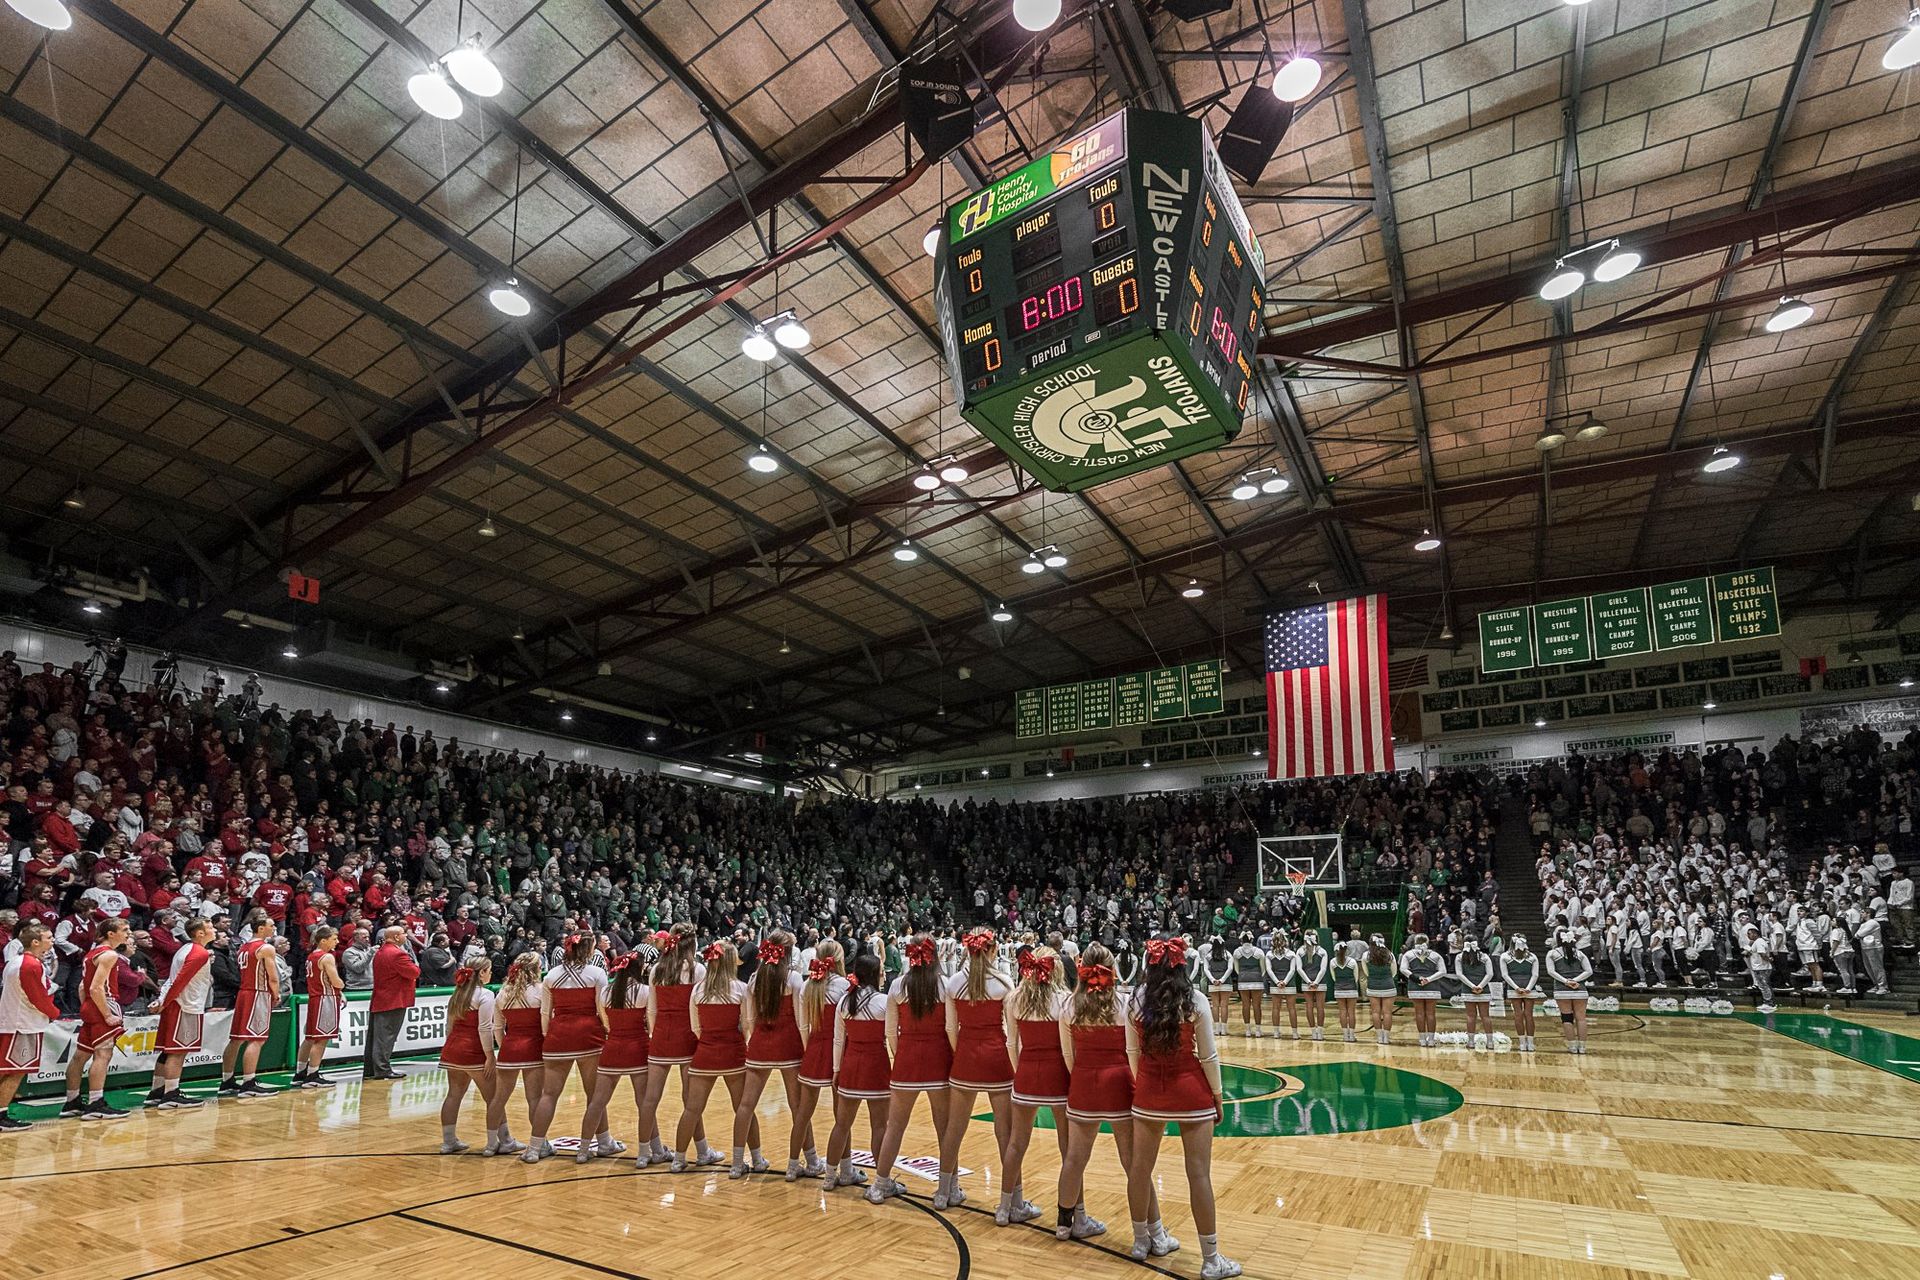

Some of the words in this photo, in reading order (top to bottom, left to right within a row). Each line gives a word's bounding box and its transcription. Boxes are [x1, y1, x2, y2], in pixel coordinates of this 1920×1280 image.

[1071, 131, 1101, 163] GO
[997, 172, 1027, 196] Henry
[997, 180, 1033, 206] County
[1142, 162, 1189, 233] NEW
[997, 186, 1039, 216] Hospital
[1101, 202, 1115, 229] 0
[1015, 212, 1050, 241] player
[1092, 258, 1135, 287] Guests
[969, 269, 983, 293] 0
[1152, 236, 1175, 330] CASTLE
[1119, 277, 1139, 314] 0
[1021, 276, 1083, 331] 8:00
[964, 322, 993, 345] Home
[984, 338, 1002, 372] 0
[1031, 340, 1067, 368] period
[1033, 363, 1101, 398] SCHOOL
[1147, 356, 1212, 425] TROJANS
[1013, 396, 1040, 422] HIGH
[1013, 424, 1066, 463] CHRYSLER
[1134, 441, 1167, 458] NEW
[1069, 453, 1129, 467] CASTLE
[1732, 574, 1755, 586] BOYS
[297, 579, 309, 599] J
[1670, 587, 1688, 596] BOYS
[1718, 584, 1772, 601] BASKETBALL
[1609, 597, 1628, 606] GIRLS
[1659, 596, 1702, 610] BASKETBALL
[1732, 598, 1760, 610] STATE
[1488, 611, 1520, 621] WRESTLING
[1543, 607, 1577, 618] WRESTLING
[1600, 606, 1640, 618] VOLLEYBALL
[1679, 608, 1700, 618] STATE
[1729, 610, 1767, 623] CHAMPS
[1496, 624, 1514, 632] STATE
[1551, 621, 1570, 630] STATE
[1618, 618, 1637, 627] STATE
[1670, 621, 1696, 631] CHAMPS
[1738, 623, 1761, 635] 1932
[1609, 630, 1634, 640] CHAMPS
[1672, 633, 1697, 643] 2006
[1553, 648, 1573, 656] 1995
[1611, 641, 1634, 650] 2007
[1497, 650, 1516, 658] 1996
[1567, 733, 1673, 752] SPORTSMANSHIP
[1452, 750, 1500, 762] SPIRIT
[1203, 772, 1267, 785] SCHOLARSHI
[1338, 902, 1387, 911] TROJANS
[406, 1024, 448, 1041] SCH
